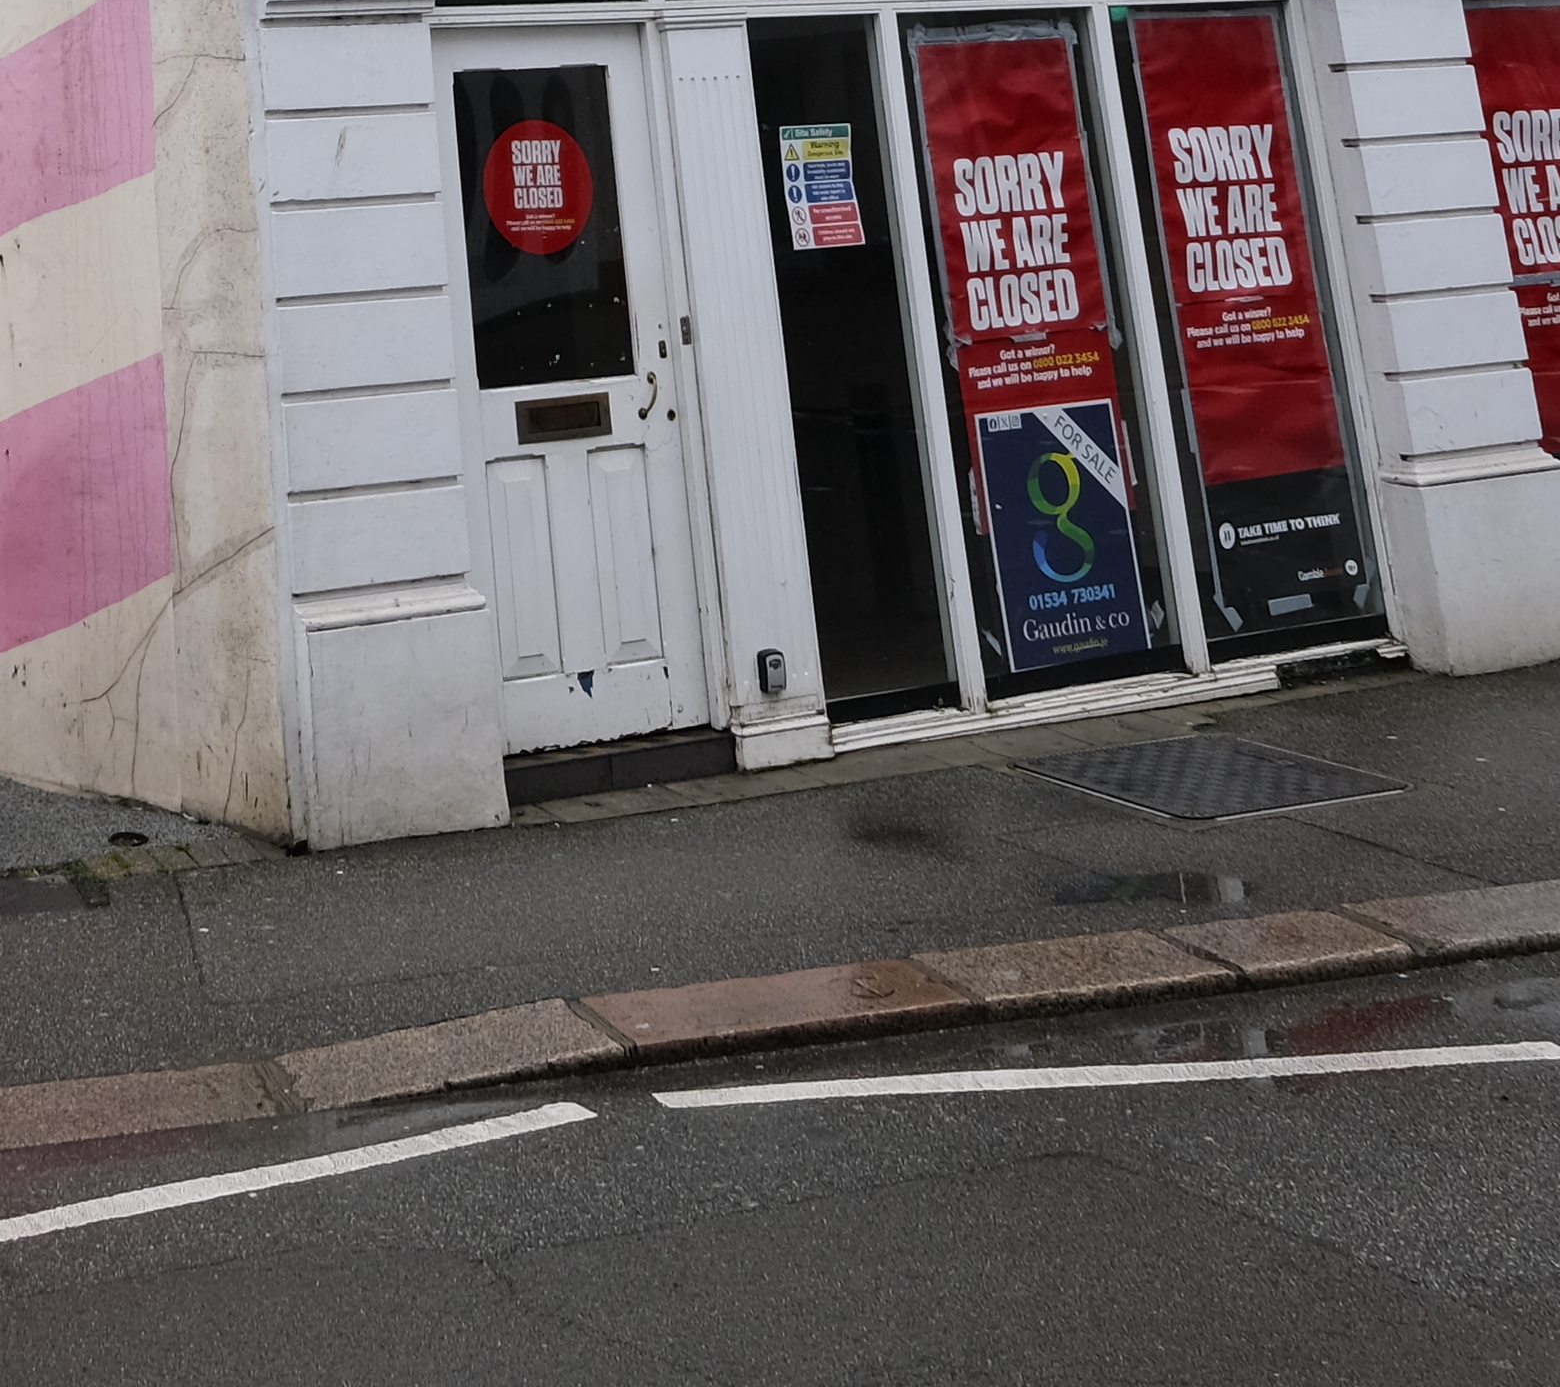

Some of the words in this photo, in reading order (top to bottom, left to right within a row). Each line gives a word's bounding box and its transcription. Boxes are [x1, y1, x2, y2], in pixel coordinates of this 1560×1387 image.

[511, 140, 561, 164] SORRY
[1168, 124, 1273, 184] SORRY
[513, 165, 534, 186] WE
[537, 165, 561, 185] ARE
[953, 151, 1065, 217] SORRY
[514, 187, 563, 209] CLOSED
[1501, 166, 1544, 214] WE
[1176, 186, 1222, 238] WE
[1227, 183, 1282, 235] ARE
[960, 219, 1010, 273] WE
[1012, 213, 1071, 268] ARE
[1186, 236, 1293, 293] CLOSED
[966, 268, 1079, 331] CLOSED
[1222, 311, 1236, 322] Got
[1237, 312, 1243, 320] a
[1186, 327, 1213, 338] Please
[1215, 323, 1228, 335] call
[1230, 324, 1239, 333] us
[1240, 323, 1251, 332] on
[1196, 338, 1211, 349] and
[1212, 338, 1224, 346] we
[1225, 334, 1240, 345] will
[1241, 334, 1252, 343] be
[1252, 332, 1275, 343] happy
[1275, 329, 1285, 339] to
[1285, 327, 1305, 339] help
[1000, 349, 1015, 360] Got
[1017, 350, 1023, 358] a
[1024, 344, 1055, 357] winner?
[968, 366, 992, 378] Please
[993, 362, 1007, 376] call
[1008, 363, 1018, 372] us
[1021, 361, 1032, 370] on
[1055, 355, 1074, 365] 022
[977, 377, 991, 389] and
[992, 378, 1003, 387] we
[1004, 374, 1019, 385] will
[1020, 373, 1032, 383] be
[1033, 370, 1058, 382] happy
[1060, 367, 1070, 377] to
[1071, 365, 1093, 376] help
[1053, 415, 1080, 451] FOR
[1081, 444, 1116, 484] SALE
[1237, 524, 1263, 539] TAKE
[1262, 520, 1289, 534] TIME
[1289, 517, 1305, 531] TO
[1304, 513, 1341, 528] THINK
[1029, 590, 1068, 610] 01534
[1071, 583, 1116, 604] 730341
[1023, 612, 1092, 641] Gaudin
[1095, 615, 1107, 630] &
[1108, 611, 1130, 628] co
